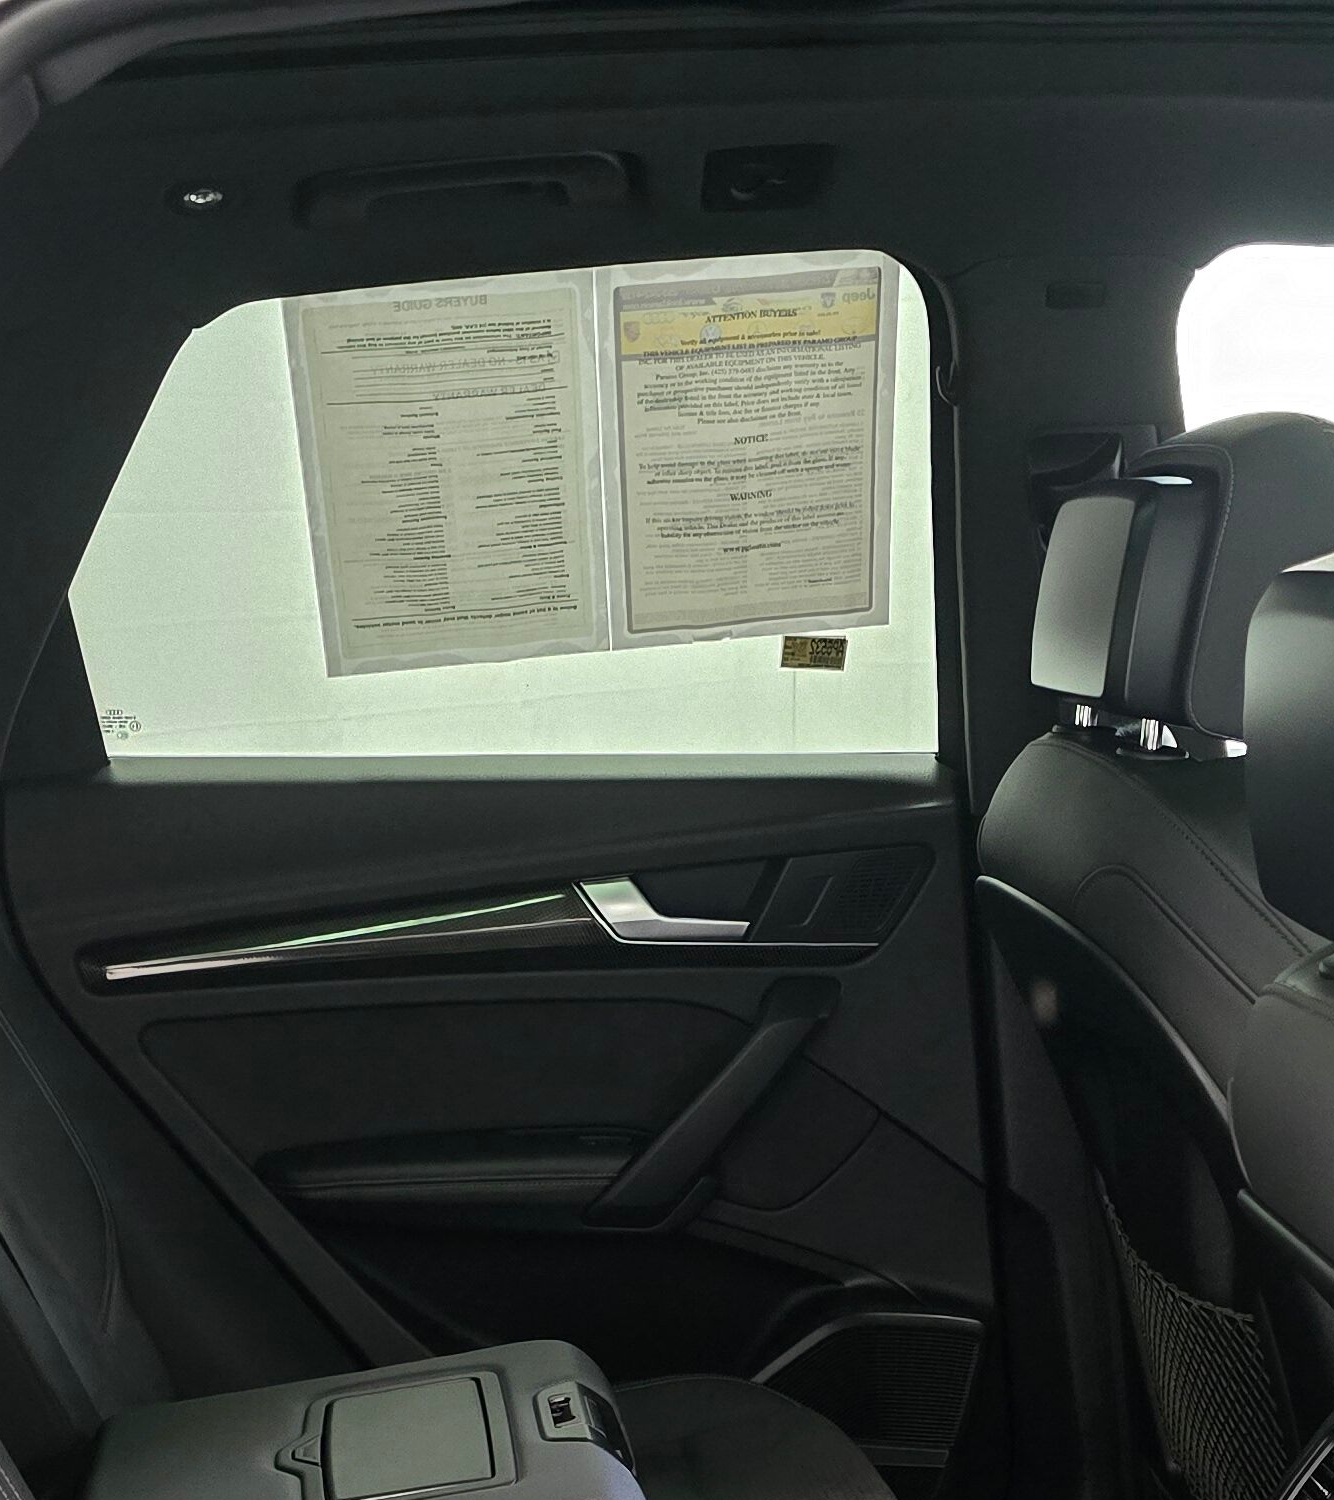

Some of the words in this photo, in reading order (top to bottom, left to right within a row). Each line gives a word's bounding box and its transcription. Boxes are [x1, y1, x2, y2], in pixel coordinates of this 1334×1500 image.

[705, 312, 757, 324] ATTENTION
[759, 308, 797, 320] BUYERS
[729, 489, 771, 501] WARNING
